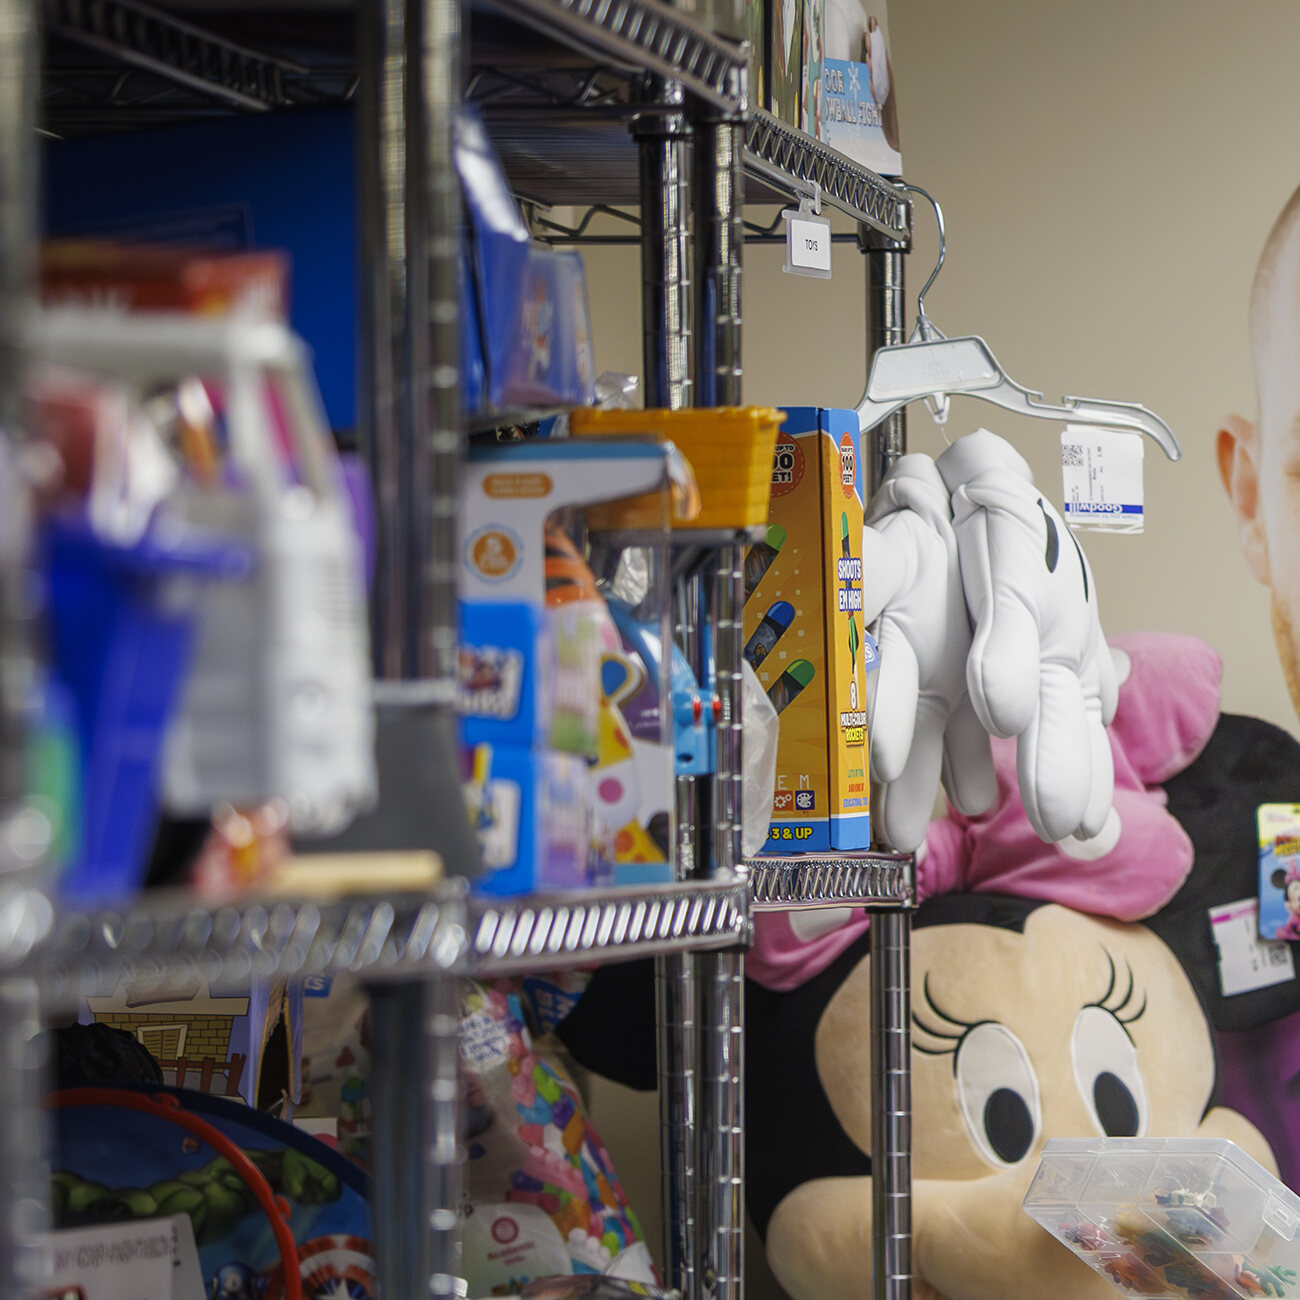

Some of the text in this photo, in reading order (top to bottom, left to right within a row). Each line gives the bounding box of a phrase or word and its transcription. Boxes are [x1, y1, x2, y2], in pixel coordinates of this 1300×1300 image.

[804, 239, 819, 251] TOYS
[1069, 502, 1123, 514] Goodwill
[838, 558, 862, 580] SHOOTS
